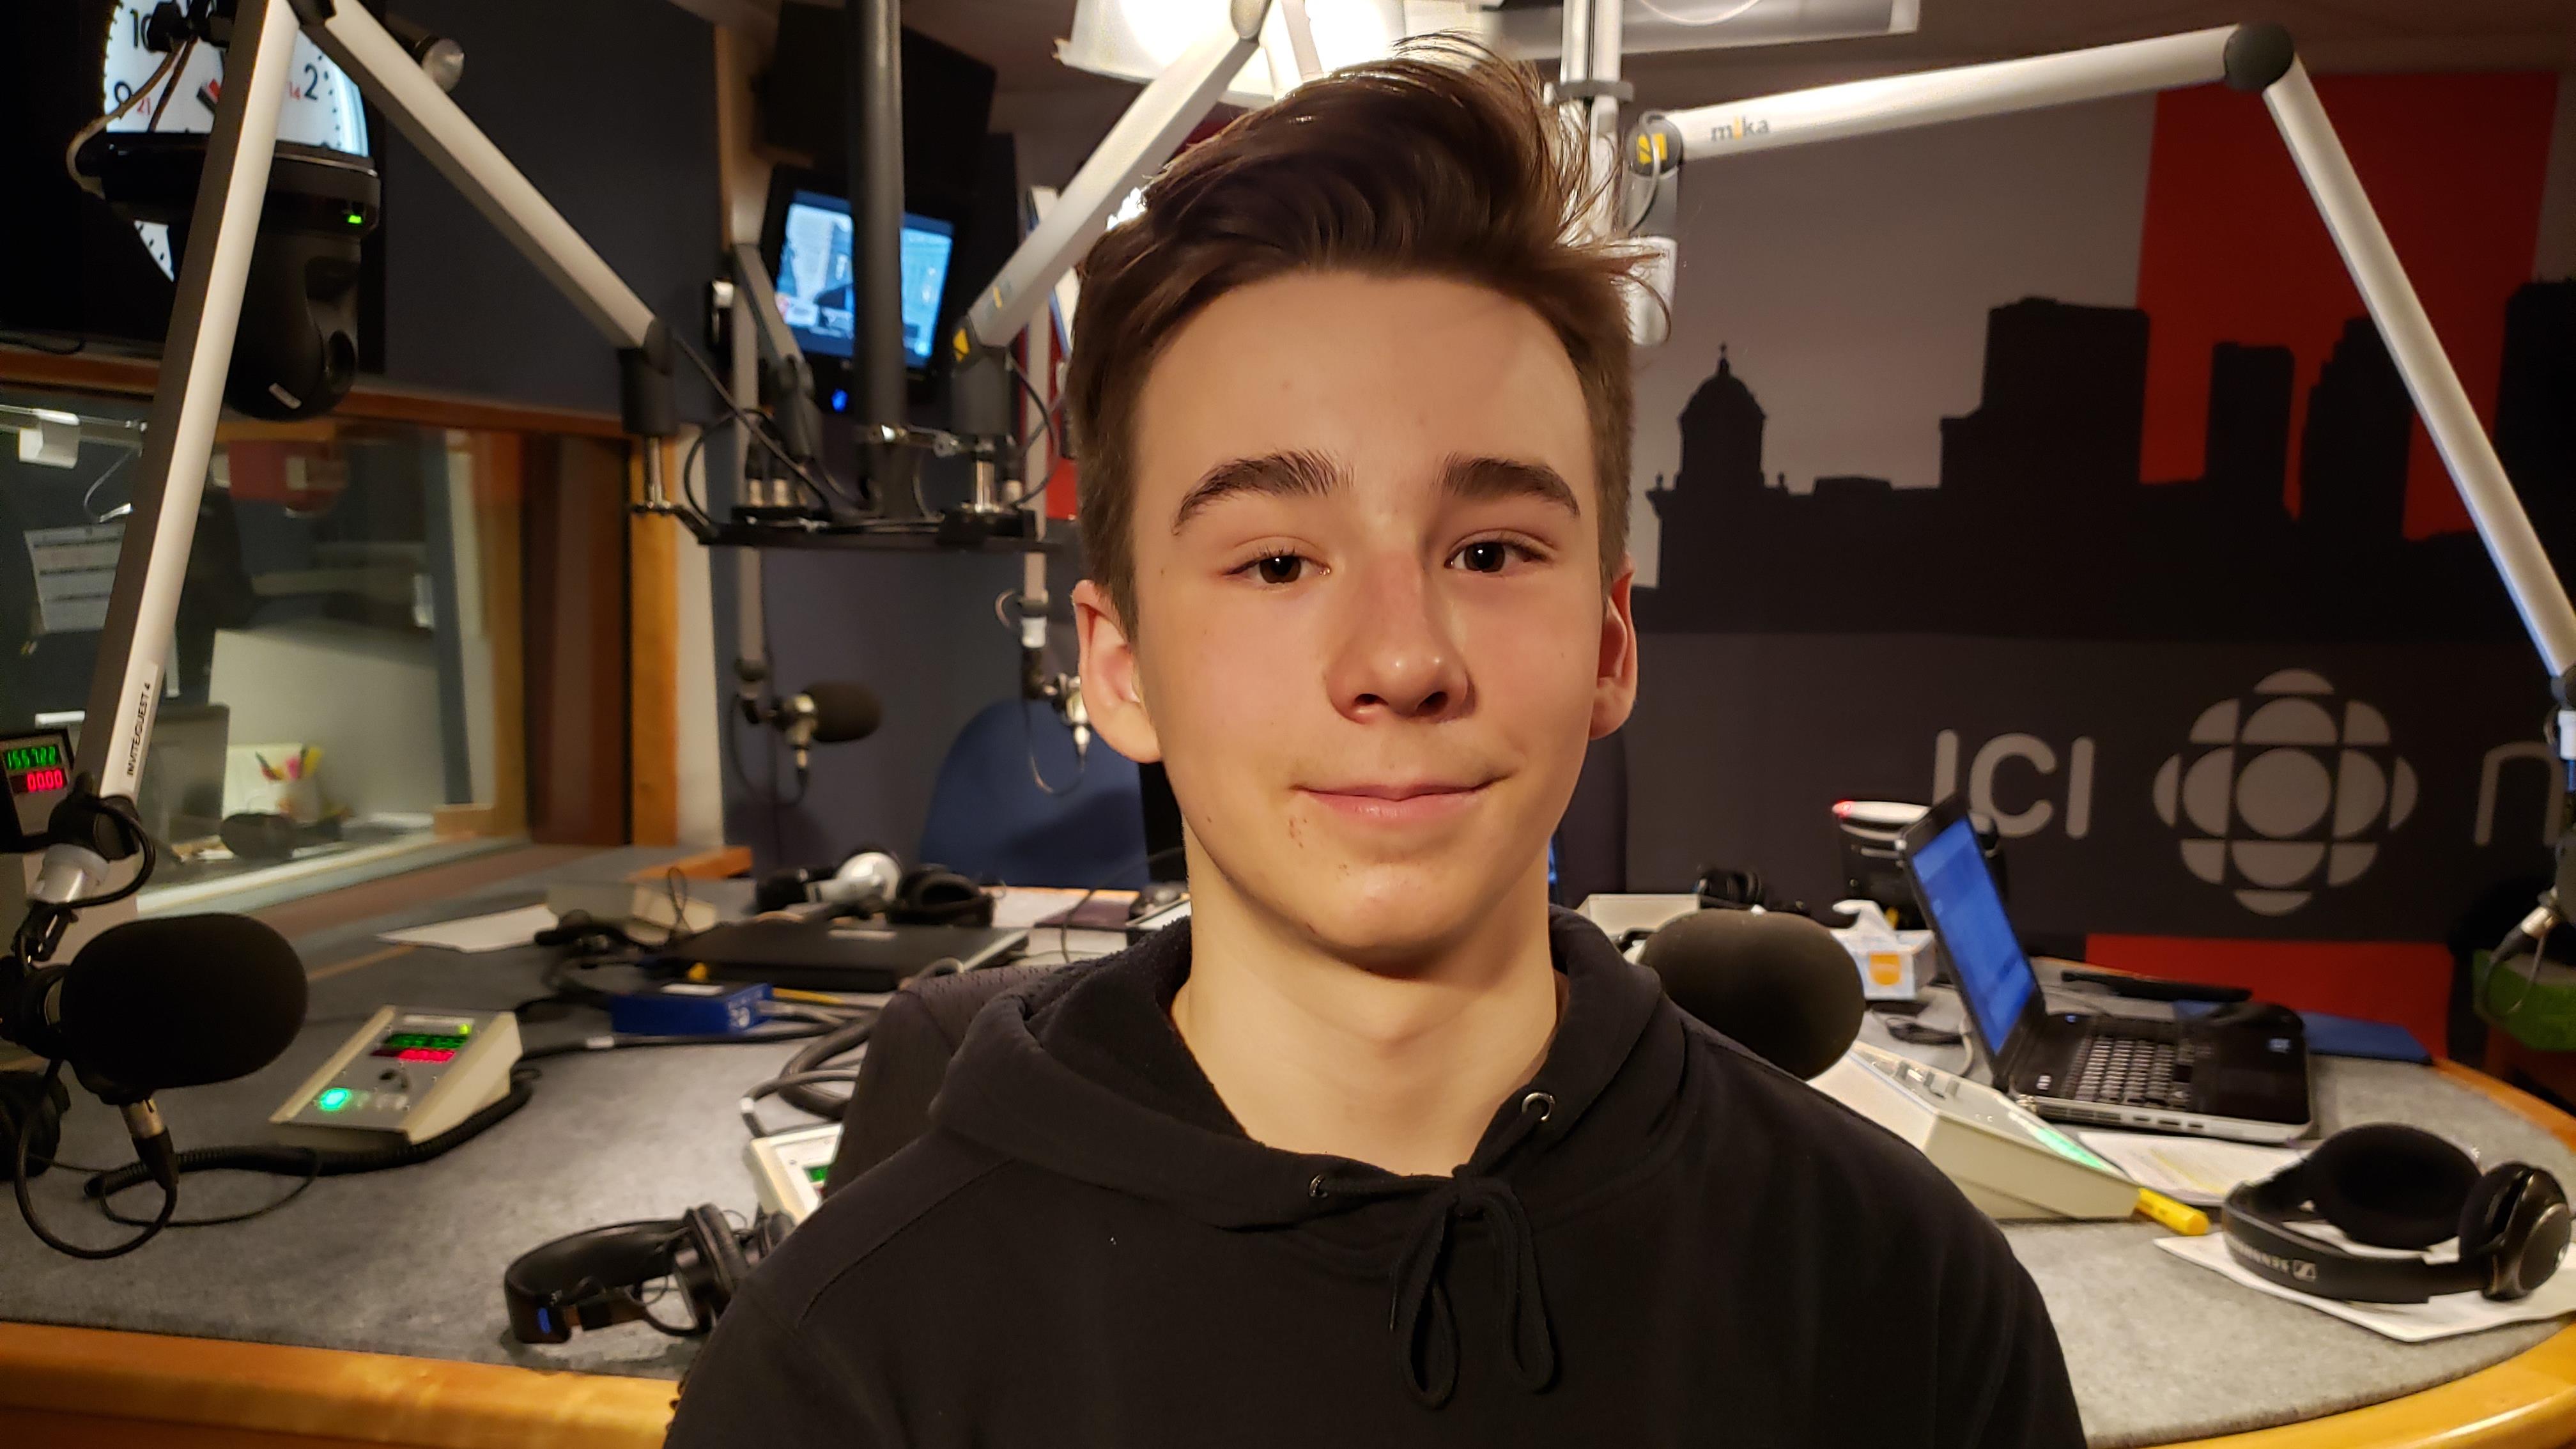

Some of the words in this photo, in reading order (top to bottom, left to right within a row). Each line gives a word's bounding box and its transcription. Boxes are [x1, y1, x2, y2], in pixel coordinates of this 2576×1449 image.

[304, 63, 318, 100] 2
[1710, 115, 1770, 142] mika
[1932, 729, 2095, 839] ICI
